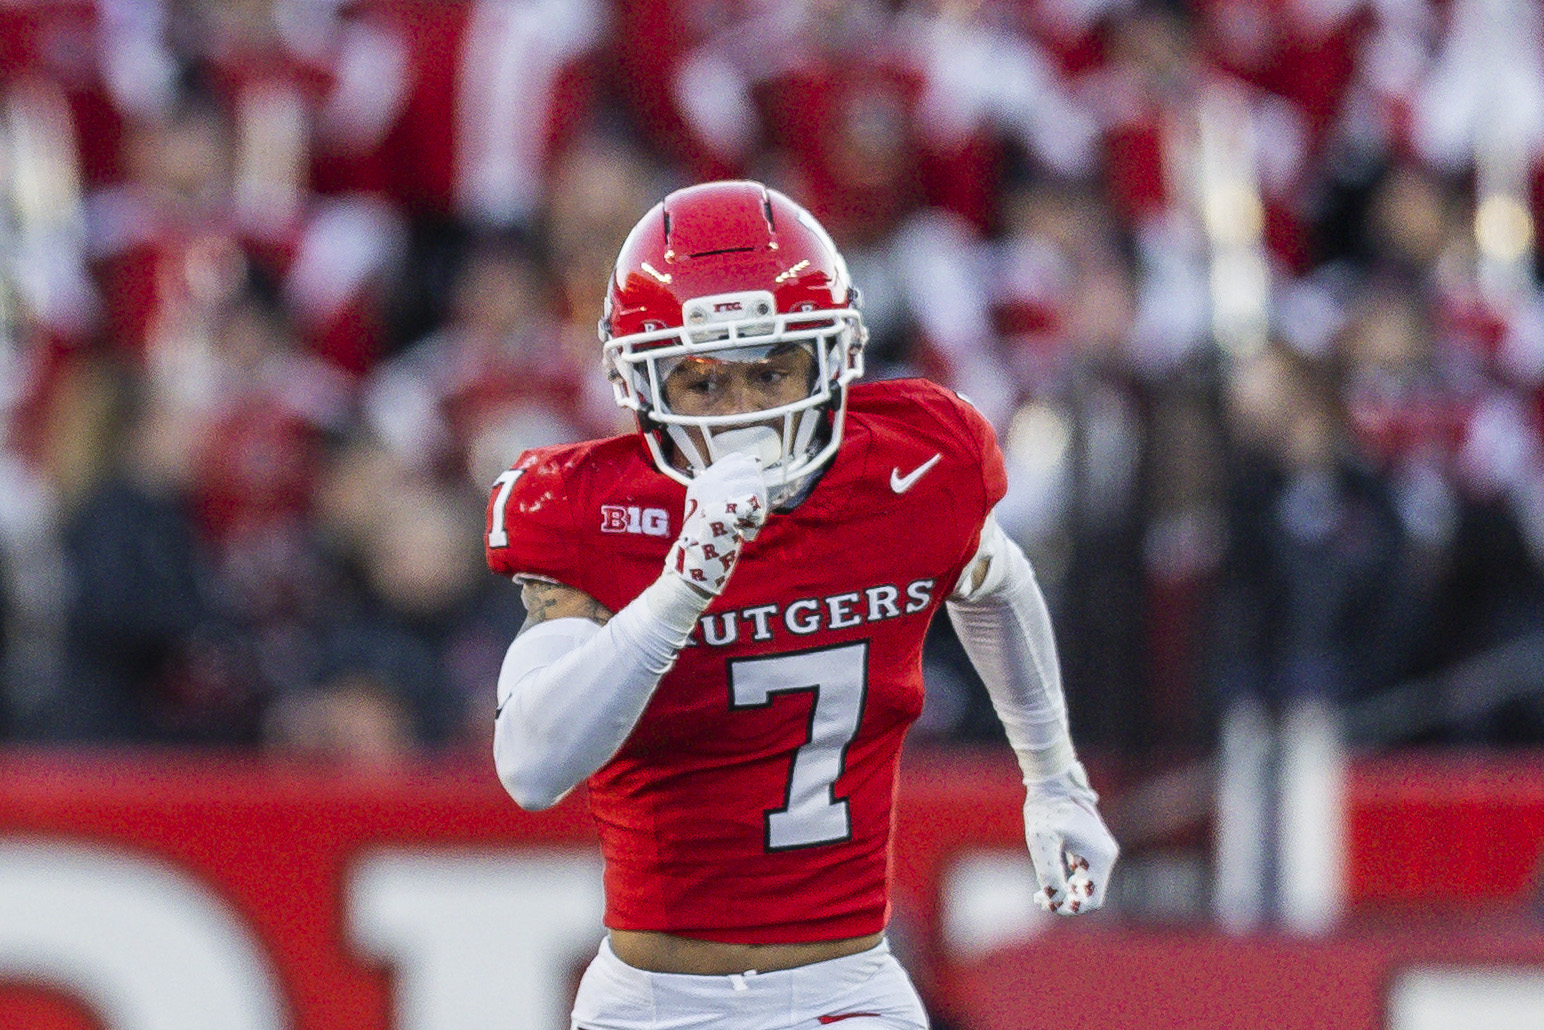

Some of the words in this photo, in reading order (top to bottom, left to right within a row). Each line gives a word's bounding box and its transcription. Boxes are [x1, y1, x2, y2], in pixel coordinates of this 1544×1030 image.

[710, 521, 728, 537] R
[702, 544, 720, 560] R
[689, 569, 708, 582] R
[682, 578, 937, 648] UTGERS
[725, 637, 871, 853] 7
